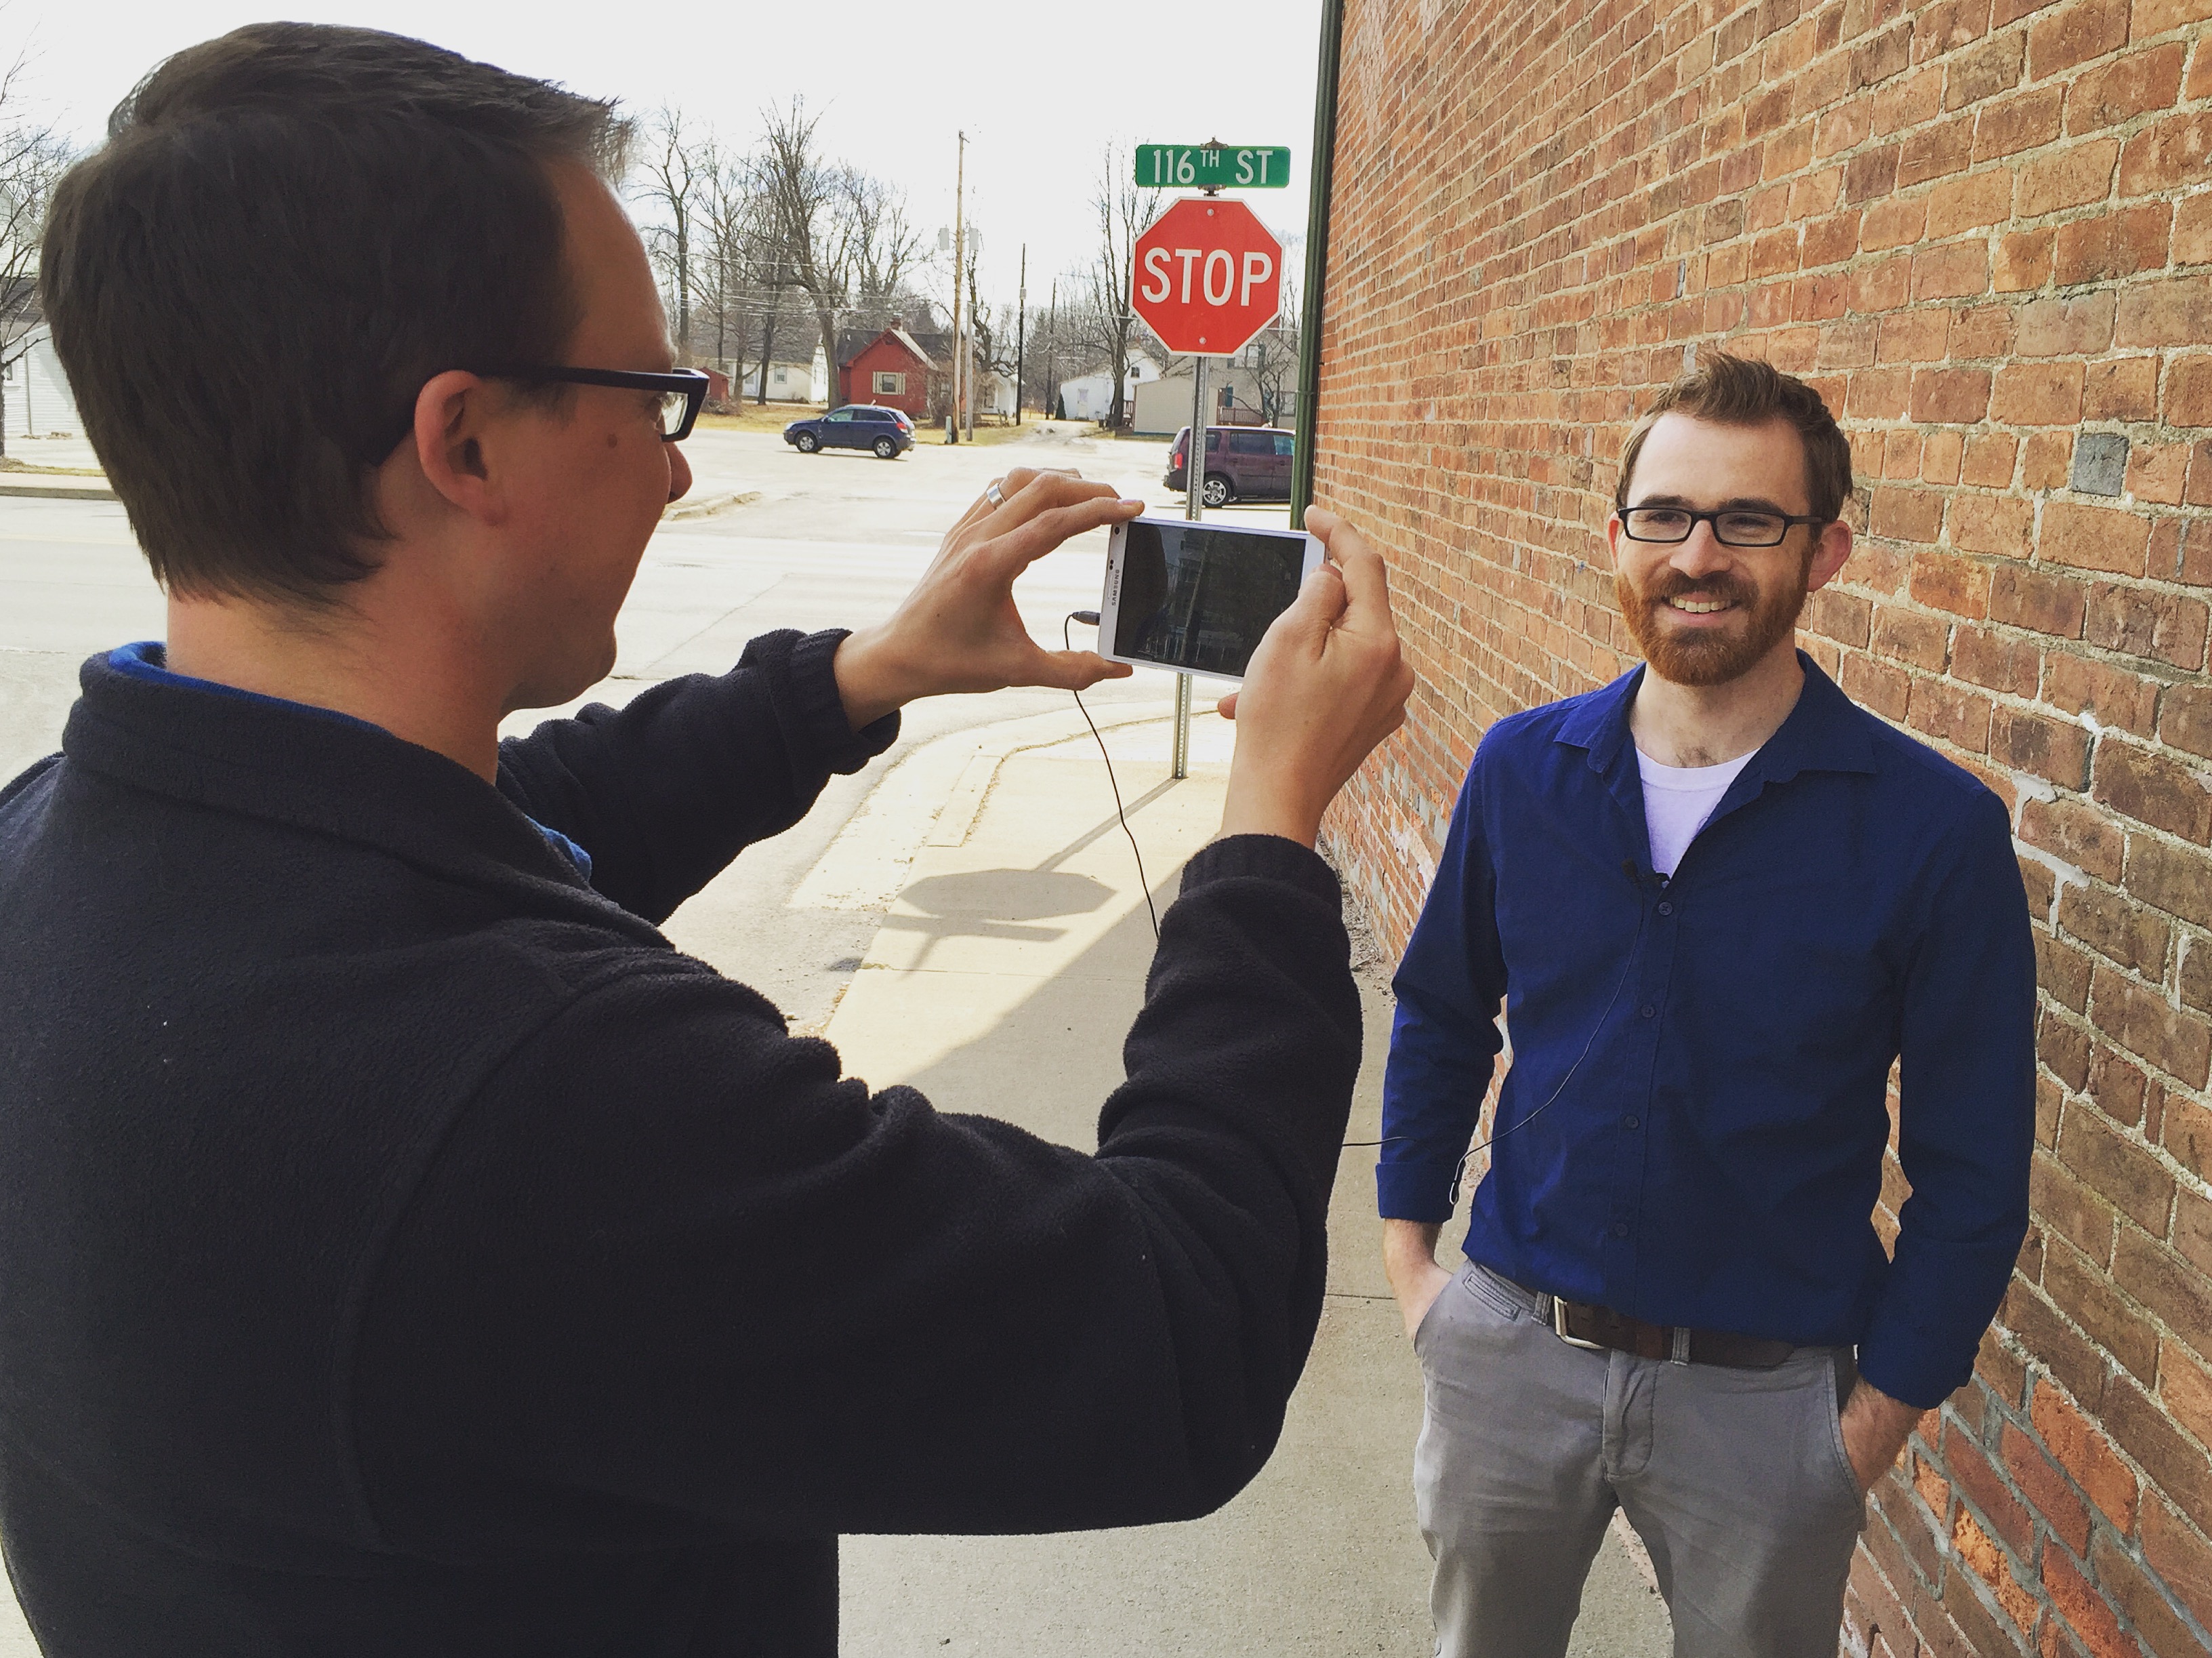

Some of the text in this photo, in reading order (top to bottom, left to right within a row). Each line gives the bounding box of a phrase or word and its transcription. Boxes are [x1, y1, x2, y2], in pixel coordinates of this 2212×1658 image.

[1235, 149, 1273, 184] ST
[1141, 247, 1273, 306] STOP
[1111, 569, 1120, 606] SAMSUNG
